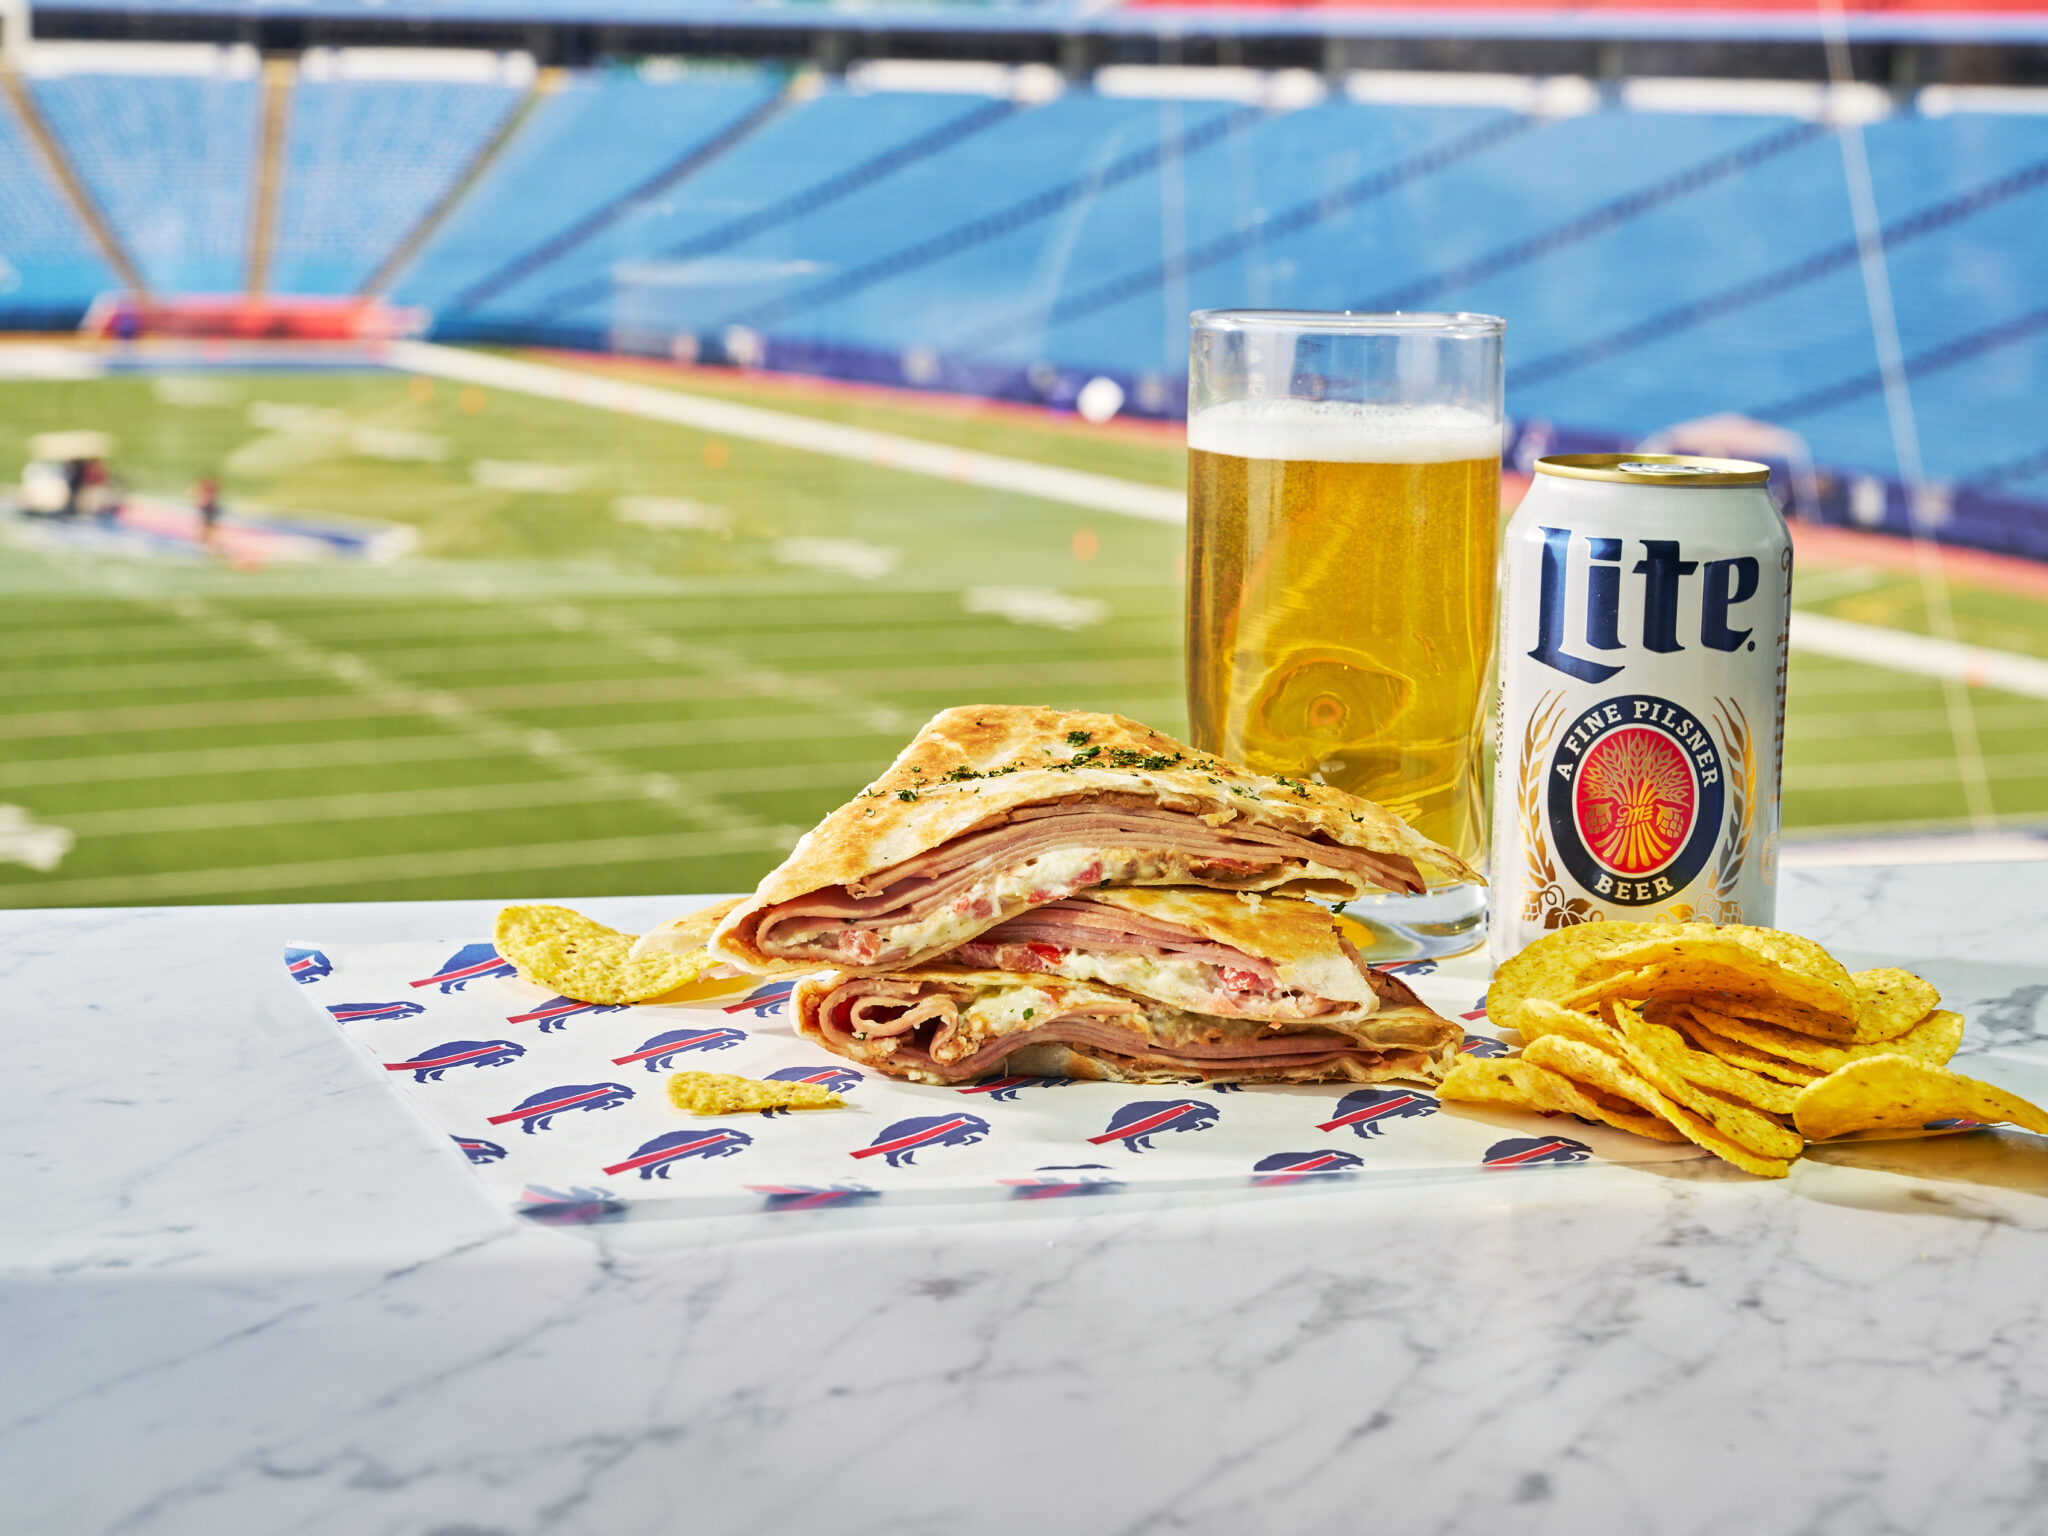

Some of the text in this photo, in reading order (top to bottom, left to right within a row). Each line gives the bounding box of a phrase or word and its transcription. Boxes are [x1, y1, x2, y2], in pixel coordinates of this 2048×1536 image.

[1528, 526, 1759, 684] Lite
[1556, 764, 1573, 781] A
[1565, 703, 1622, 756] FINE
[1634, 701, 1718, 787] PILSNER
[1594, 874, 1674, 901] BEER
